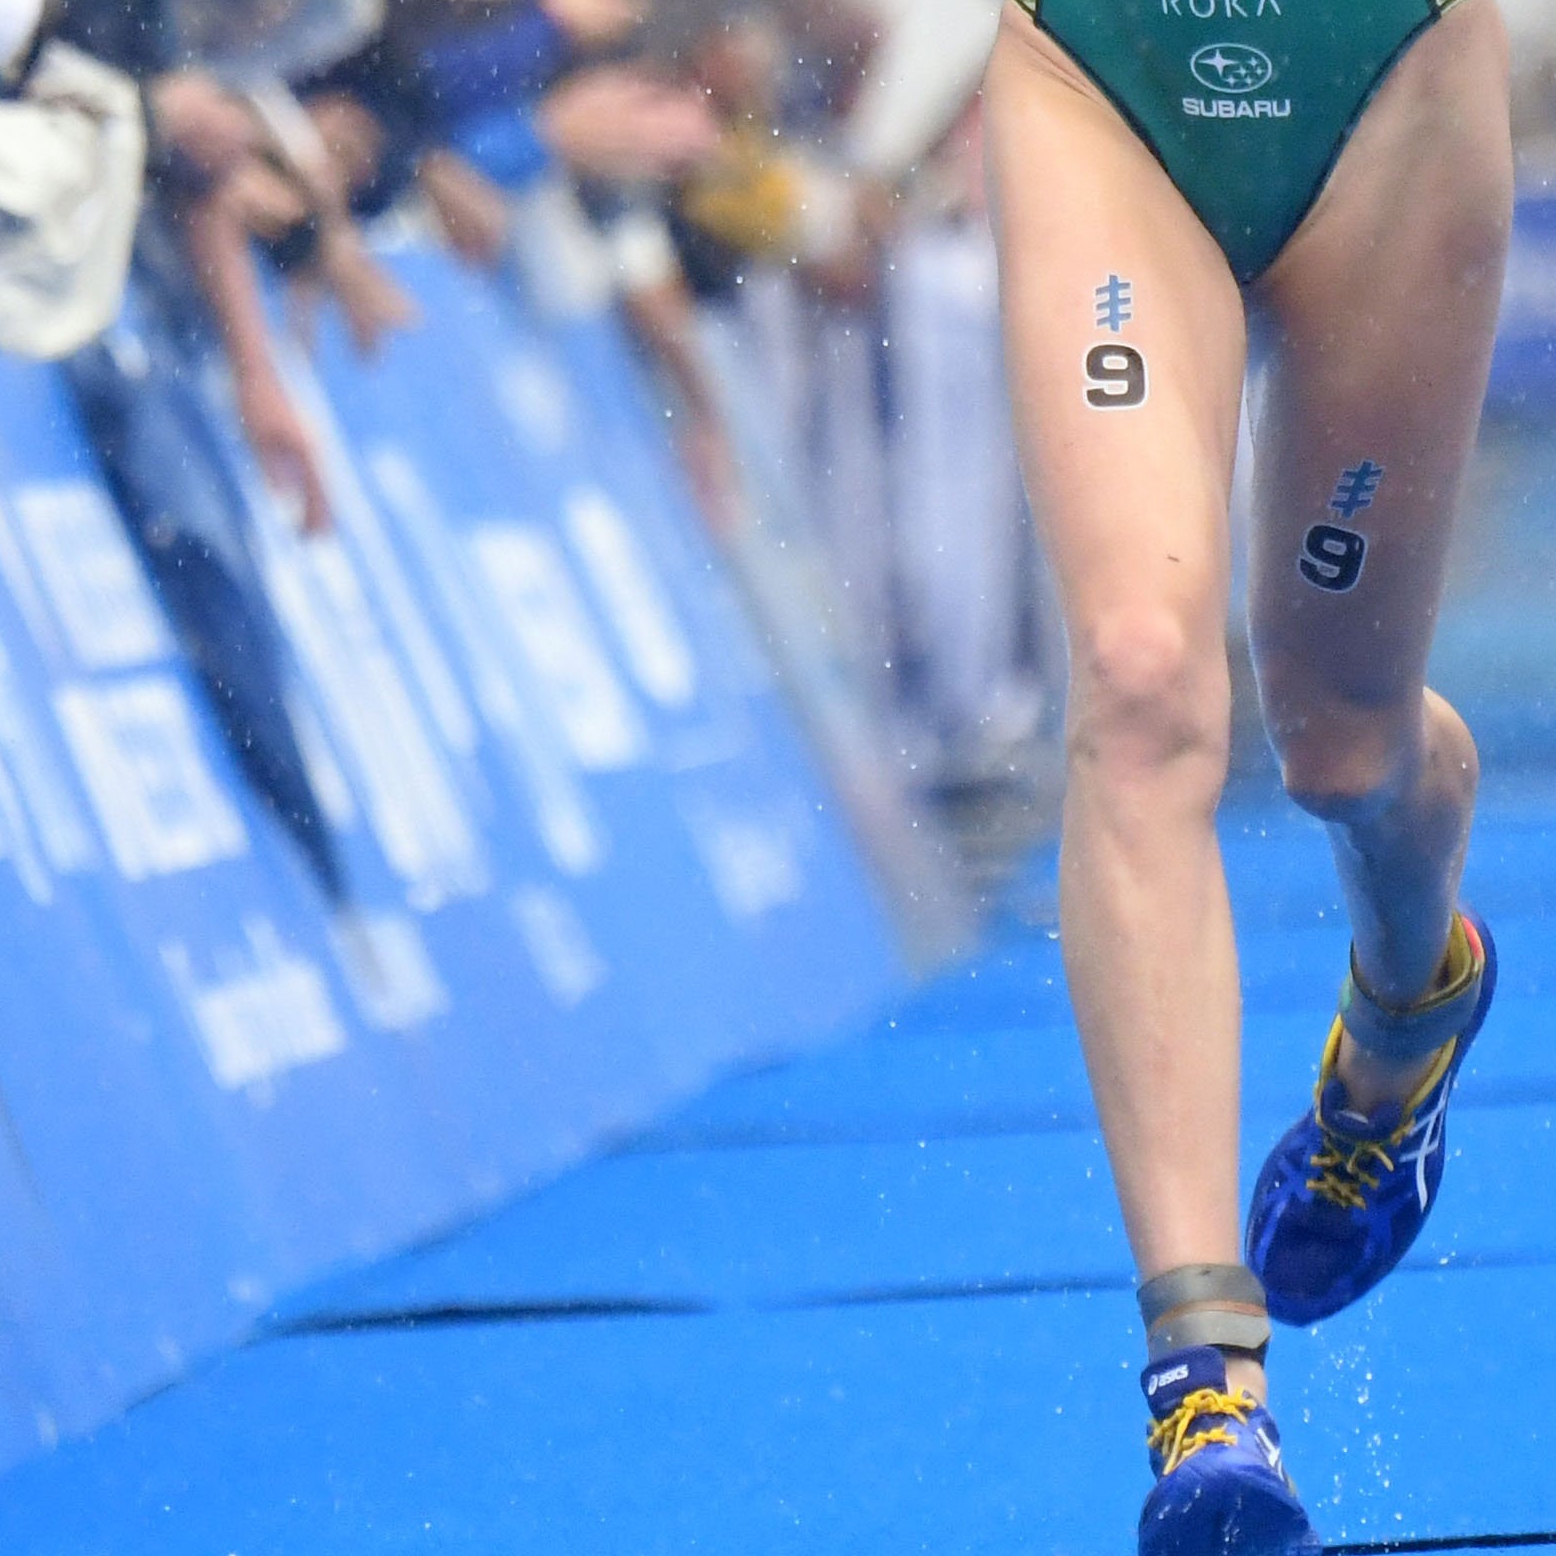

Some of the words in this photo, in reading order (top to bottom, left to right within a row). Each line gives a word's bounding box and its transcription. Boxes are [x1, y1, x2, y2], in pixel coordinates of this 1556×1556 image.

[1182, 97, 1292, 119] SUBARU
[1082, 343, 1149, 411] 9
[1297, 523, 1368, 593] 9
[1158, 1363, 1189, 1387] asics
